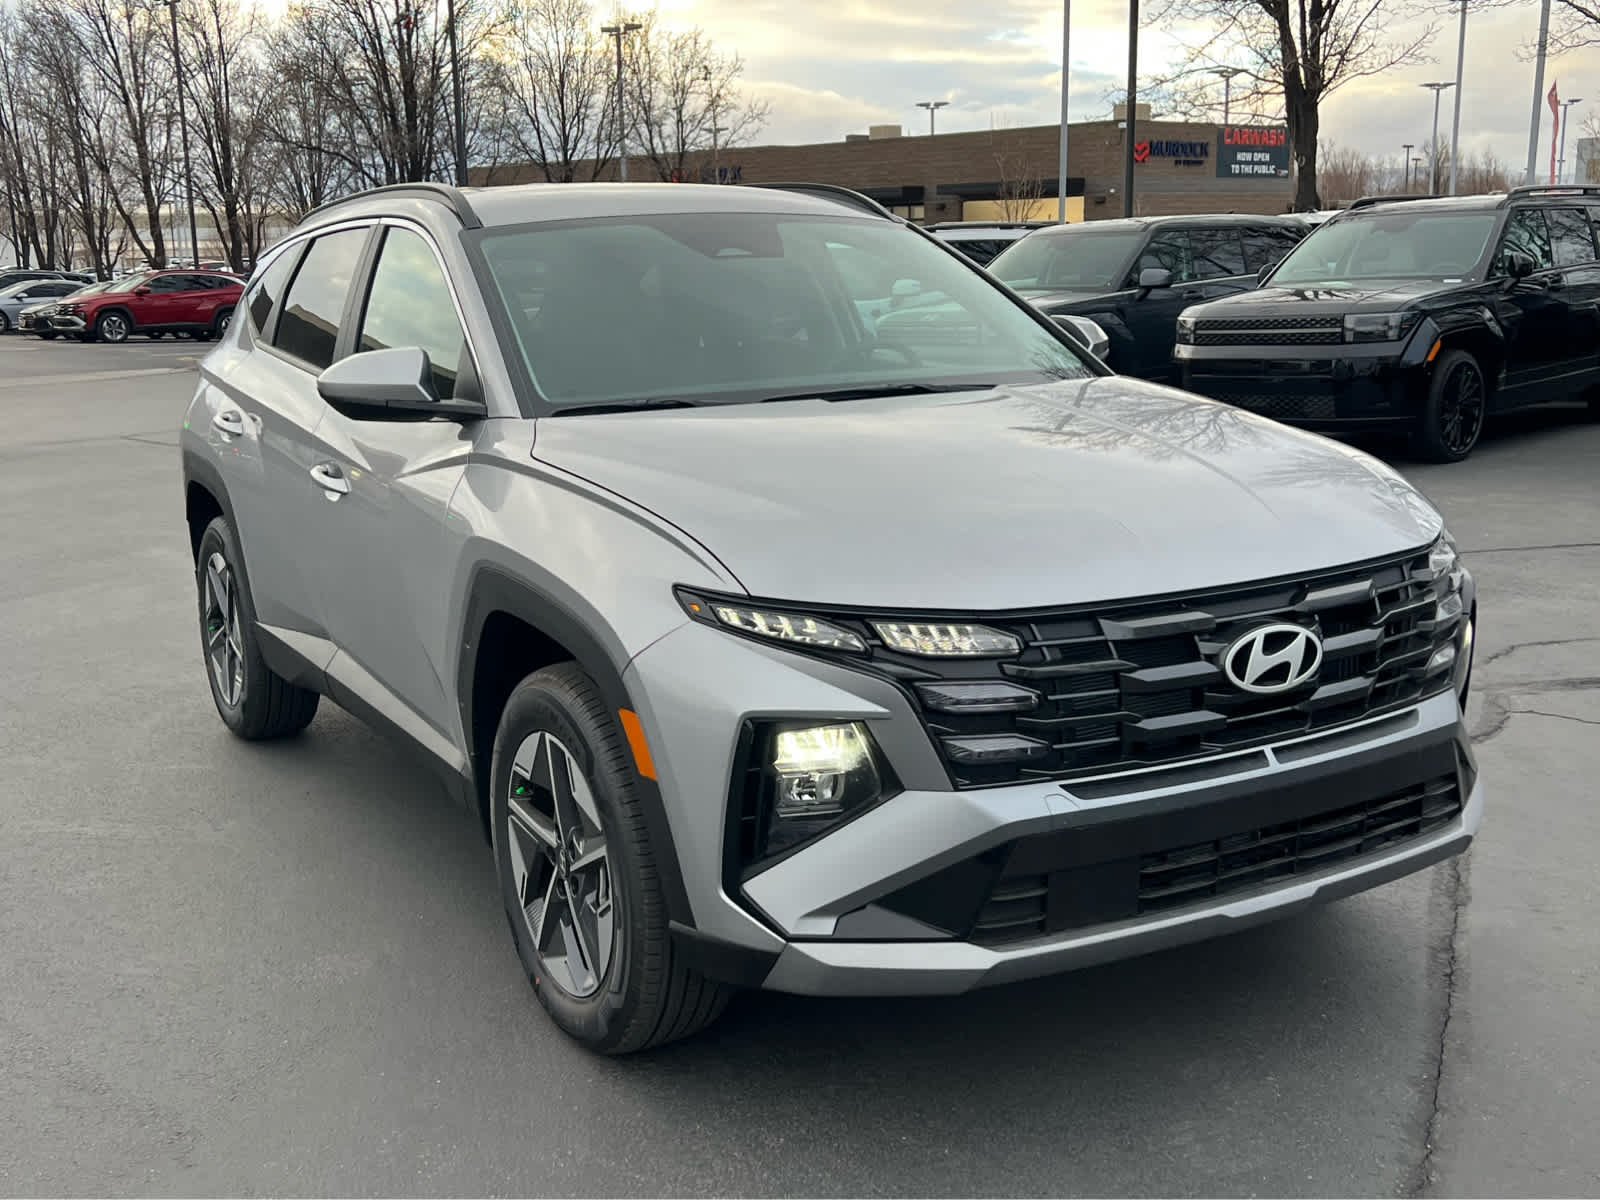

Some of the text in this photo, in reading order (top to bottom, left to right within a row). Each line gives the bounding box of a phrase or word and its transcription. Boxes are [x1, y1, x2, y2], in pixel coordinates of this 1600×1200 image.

[1224, 127, 1286, 145] CARWASH
[1150, 140, 1208, 157] MURDOCK
[1236, 152, 1270, 161] NOW OPEN
[1231, 164, 1240, 174] TO
[1241, 164, 1253, 174] THE
[1253, 164, 1276, 174] PUBLIC
